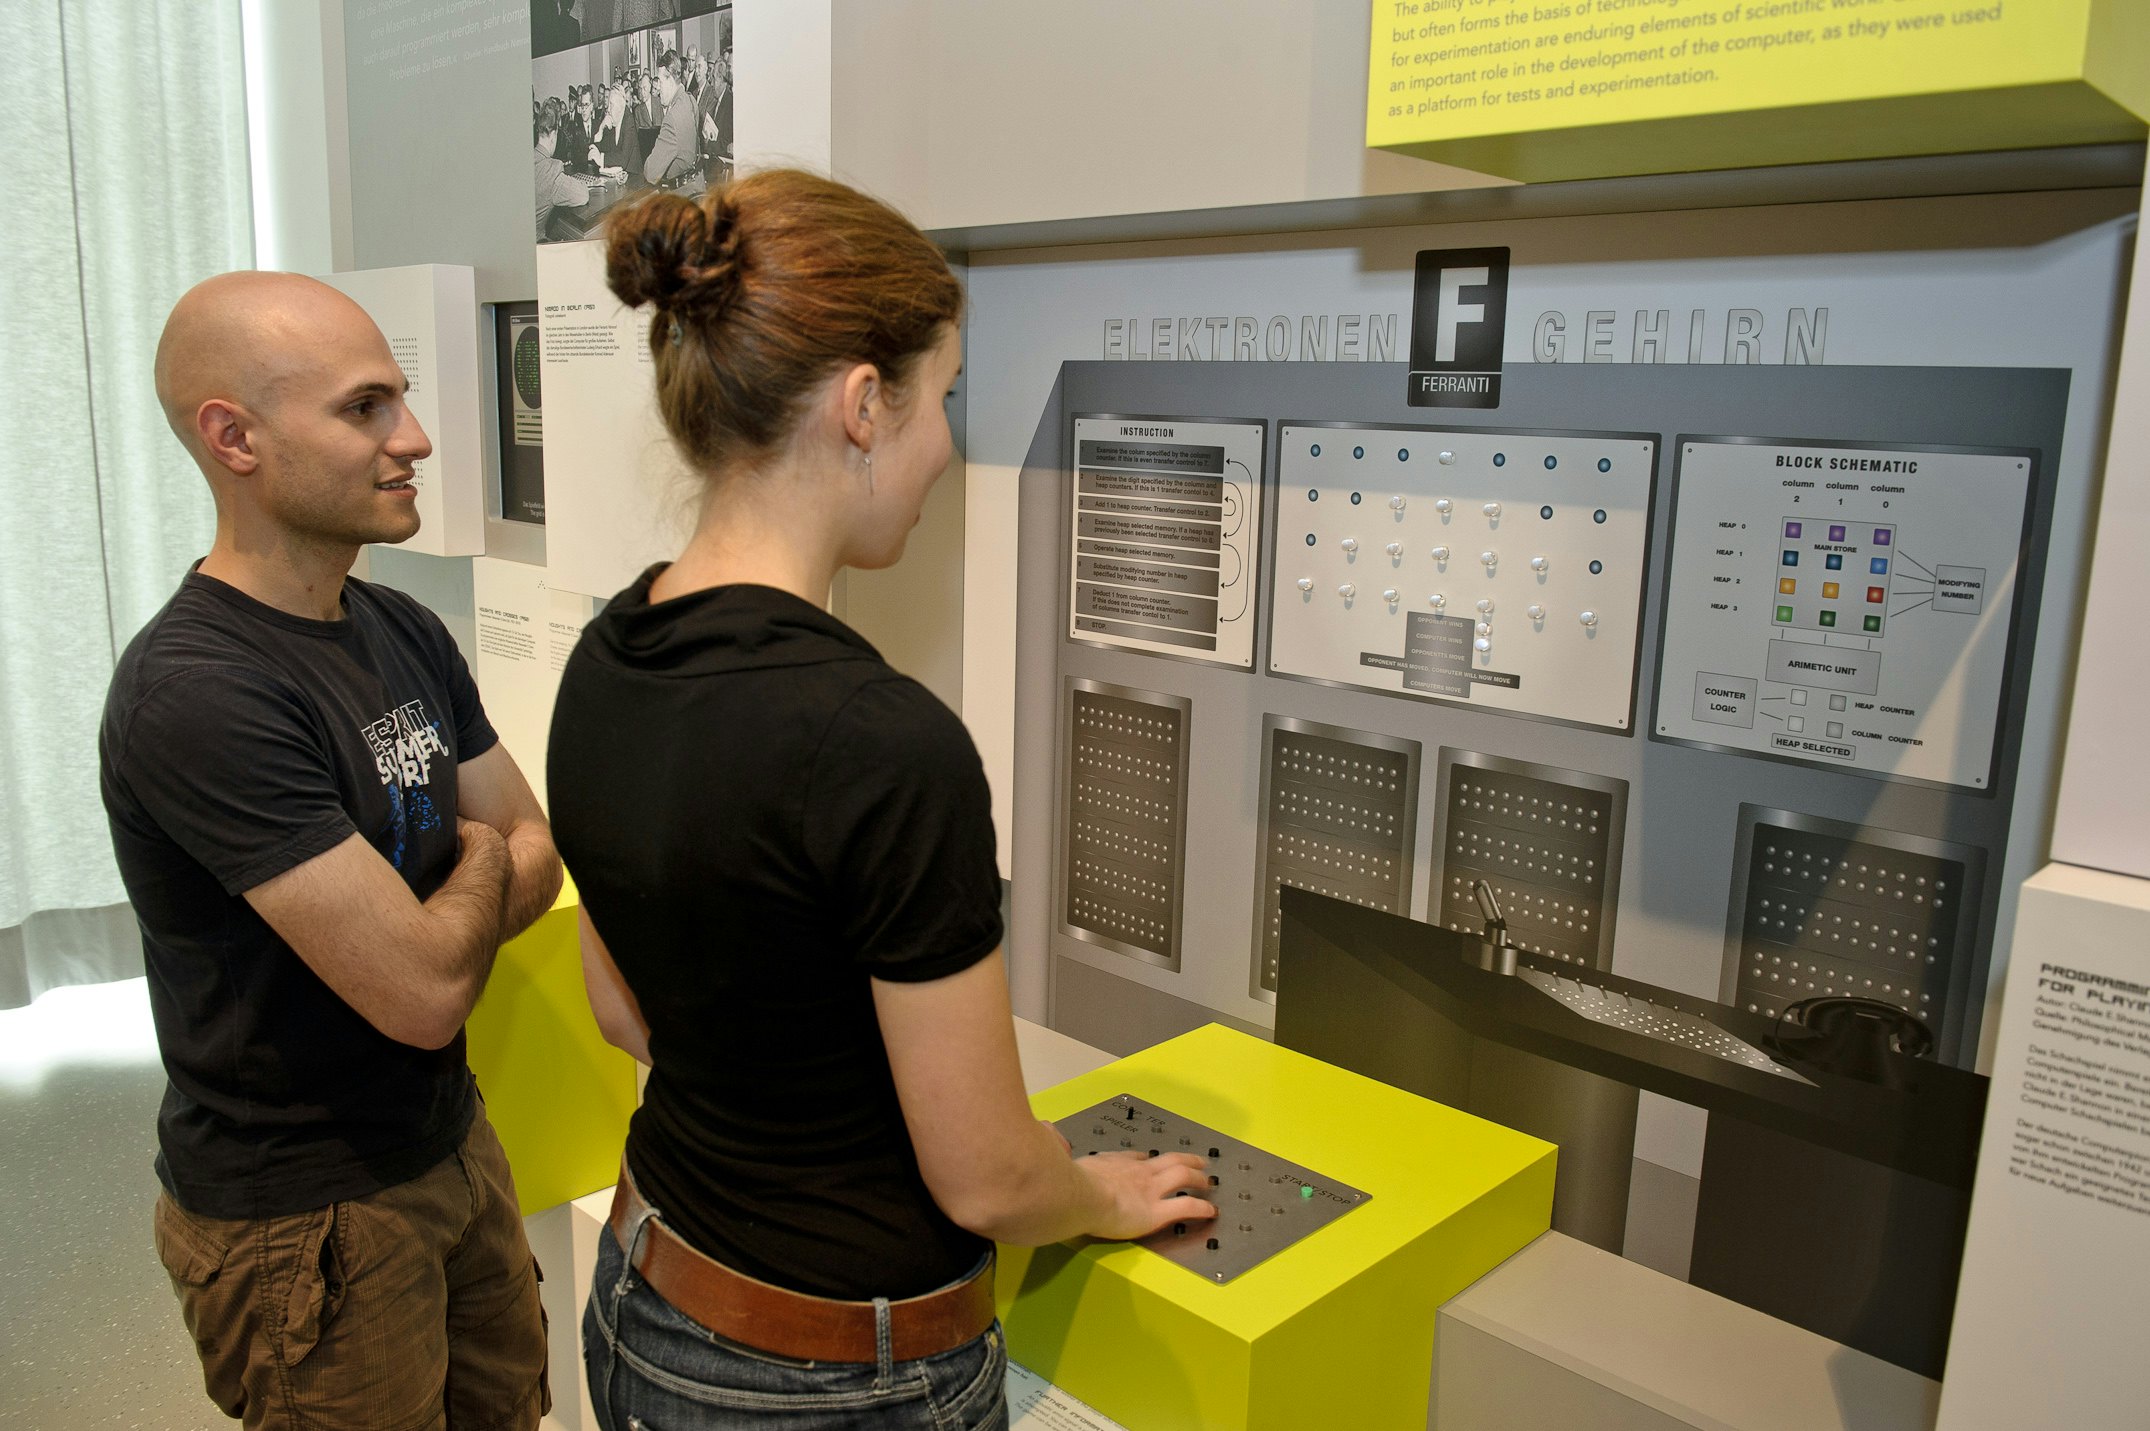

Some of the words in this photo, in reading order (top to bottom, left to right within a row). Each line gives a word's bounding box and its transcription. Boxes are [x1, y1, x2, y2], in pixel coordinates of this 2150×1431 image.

[1395, 3, 1418, 17] The
[1392, 28, 1415, 42] but
[1419, 21, 1455, 39] often
[1460, 12, 1500, 31] forms
[1505, 9, 1528, 26] the
[1533, 4, 1571, 22] basis
[1576, 1, 1592, 16] of
[1392, 52, 1409, 67] for
[1414, 36, 1530, 65] experimentation
[1535, 32, 1558, 47] are
[1564, 22, 1635, 44] enduring
[1640, 12, 1716, 34] elements
[1722, 4, 1742, 23] of
[1390, 79, 1405, 92] an
[1410, 69, 1476, 91] important
[1481, 64, 1508, 80] role
[1513, 62, 1526, 76] in
[1531, 58, 1554, 74] the
[1560, 46, 1664, 71] development
[1670, 40, 1688, 58] of
[1692, 37, 1719, 56] the
[1725, 27, 1815, 51] computer,
[1822, 25, 1842, 41] as
[1848, 17, 1891, 39] they
[1896, 12, 1945, 32] were
[1951, 3, 2003, 26] used
[1388, 104, 1402, 117] as
[1406, 103, 1414, 115] a
[1418, 94, 1477, 116] platform
[1482, 90, 1502, 106] for
[1507, 87, 1541, 104] tests
[1545, 80, 1575, 98] and
[1579, 67, 1719, 97] experimentation.
[1434, 266, 1490, 362] F
[1103, 313, 1399, 362] ELEKTRONEN
[1533, 307, 1830, 365] GEHIRN
[1421, 376, 1490, 395] FERRANTI
[1120, 427, 1174, 438] INSTRUCTION
[1776, 455, 1823, 470] BLOCK
[1829, 458, 1918, 474] SCHEMATIC
[1140, 478, 1165, 486] specified
[1782, 479, 1815, 489] column
[1826, 481, 1859, 491] column
[1870, 483, 1905, 494] column
[1154, 505, 1176, 513] Transfer
[1793, 495, 1800, 503] 2
[1838, 498, 1843, 506] 1
[1882, 501, 1889, 509] 0
[1718, 521, 1737, 530] HEAP
[1094, 544, 1114, 552] Operate
[1115, 546, 1128, 554] heap
[1129, 548, 1151, 556] selected
[1152, 551, 1175, 559] memory.
[1716, 549, 1734, 557] HEAP
[1814, 544, 1832, 552] MAIN
[1833, 545, 1857, 553] STORE
[1093, 570, 1116, 579] specified
[1138, 575, 1160, 583] counter.
[1094, 563, 1119, 571] Substitute
[1120, 565, 1145, 575] modifying
[1146, 568, 1167, 576] number
[1713, 576, 1732, 584] HEAP
[1938, 578, 1981, 590] MODIFYING
[1092, 589, 1111, 597] Deduct
[1129, 594, 1149, 602] column
[1150, 597, 1171, 605] counter.
[1941, 591, 1975, 600] NUMBER
[1711, 603, 1729, 611] HEAP
[1449, 620, 1464, 628] WINS
[1416, 633, 1447, 643] COMPUTER
[1448, 637, 1463, 645] WINS
[1449, 653, 1465, 662] MOVE
[1367, 657, 1396, 667] OPPONENT
[1397, 661, 1408, 669] HAS
[1431, 667, 1463, 678] COMPUTER
[1464, 671, 1477, 679] WILL
[1478, 673, 1493, 681] NOW
[1493, 676, 1511, 684] MOVE
[1788, 660, 1832, 673] ARIMETIC
[1834, 665, 1857, 676] UNIT
[1410, 680, 1444, 691] COMPUTERS
[1445, 685, 1462, 694] MOVE
[1704, 687, 1746, 700] COUNTER
[1710, 703, 1737, 714] LOGIC
[1854, 702, 1874, 711] HEAP
[1880, 705, 1915, 716] COUNTER
[1851, 730, 1882, 740] COLUMN
[1888, 735, 1923, 746] COUNTER
[1776, 738, 1800, 749] HEAP
[1802, 742, 1851, 757] SELECTED
[2038, 978, 2075, 995] FOR
[1100, 1115, 1139, 1133] SPIELER
[1281, 1173, 1351, 1205] START/STOP
